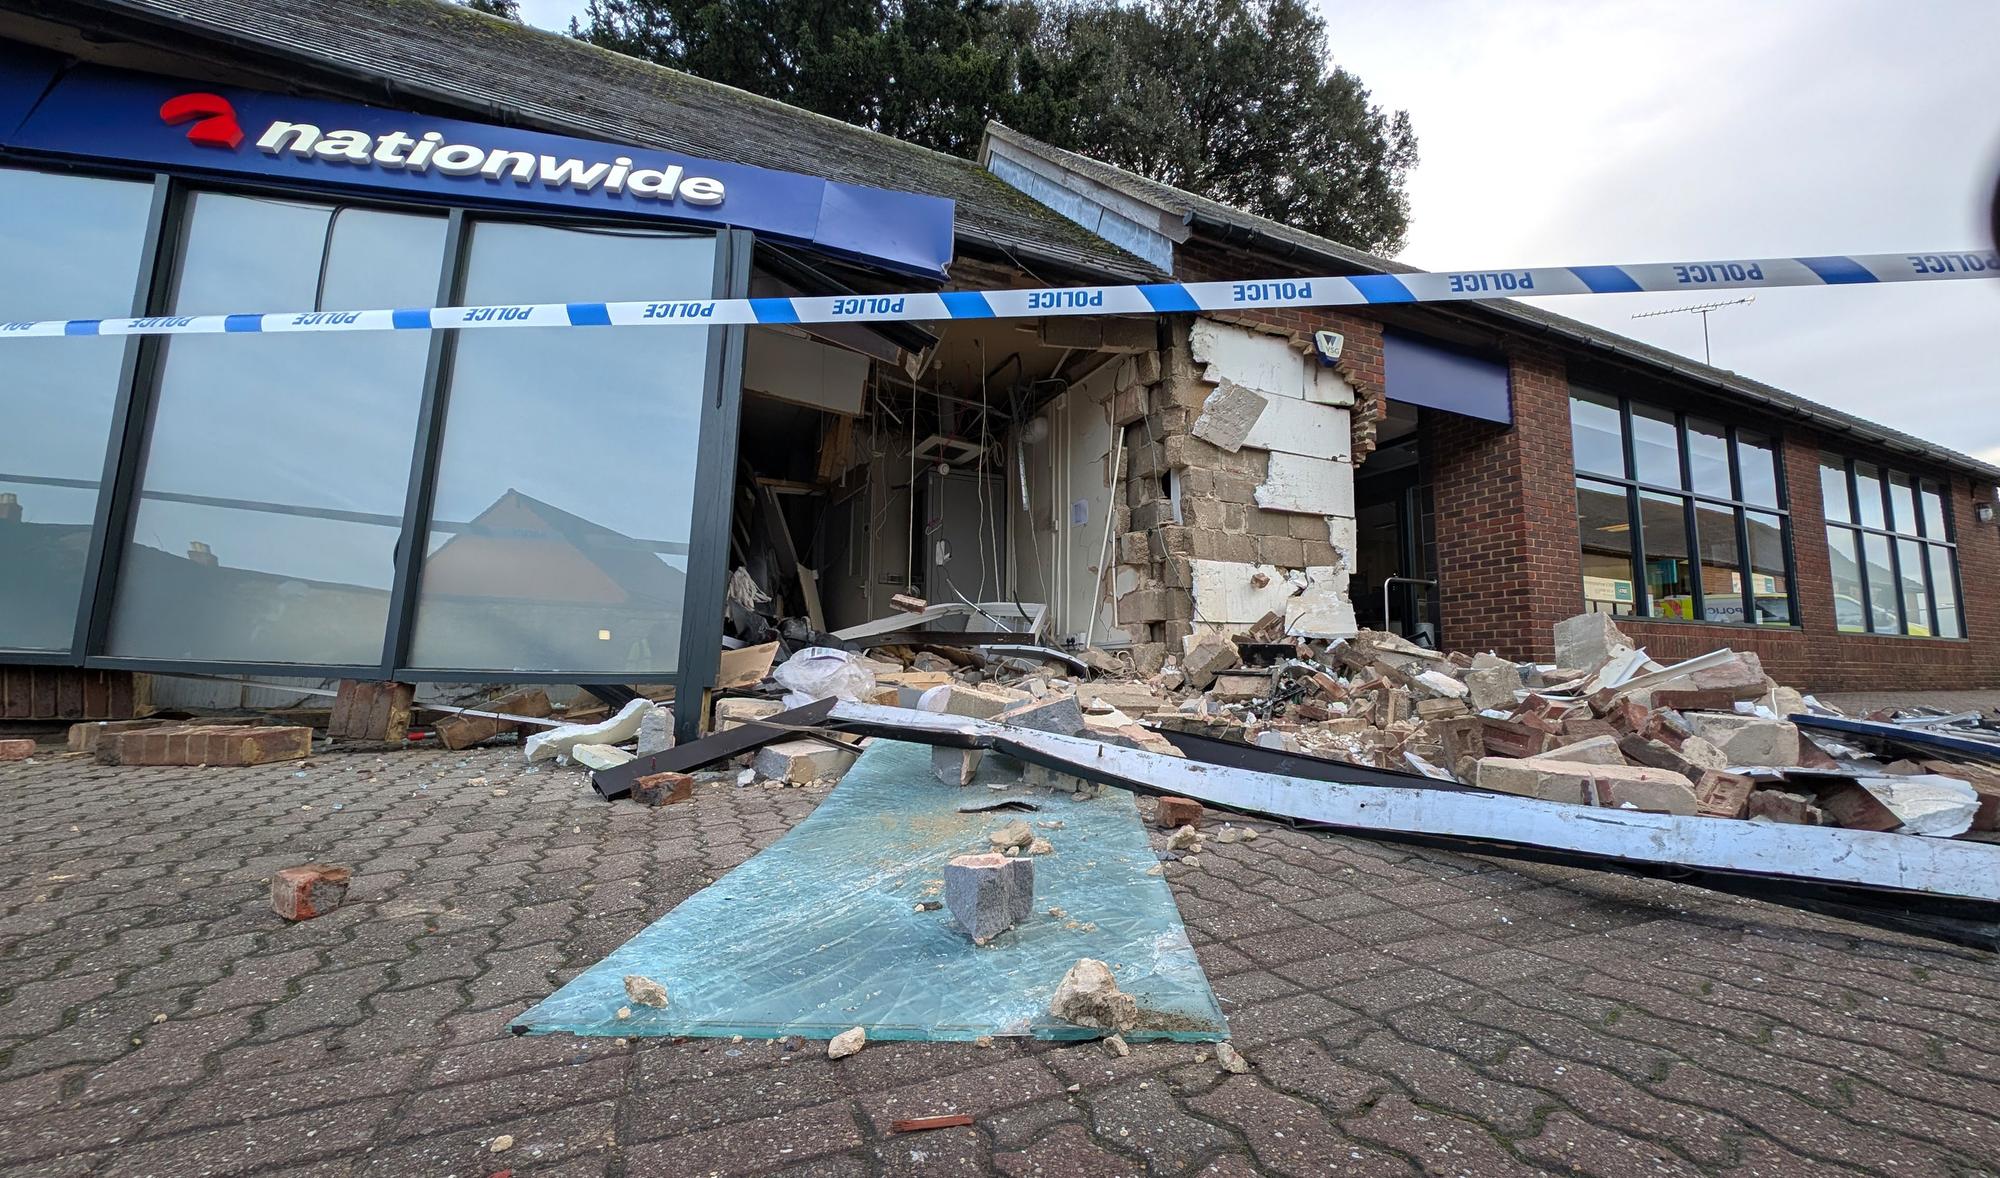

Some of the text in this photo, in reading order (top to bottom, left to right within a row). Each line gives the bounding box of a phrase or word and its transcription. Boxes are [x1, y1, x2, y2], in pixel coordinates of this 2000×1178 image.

[256, 120, 725, 205] nationwide
[1448, 272, 1534, 292] POLICE
[1673, 263, 1764, 283] POLICE
[1028, 290, 1103, 309] POLICE
[1233, 282, 1312, 301] POLICE
[463, 307, 533, 321] POLICE
[643, 302, 715, 318] POLICE
[832, 297, 904, 315] POLICE
[292, 311, 361, 325] POLICE
